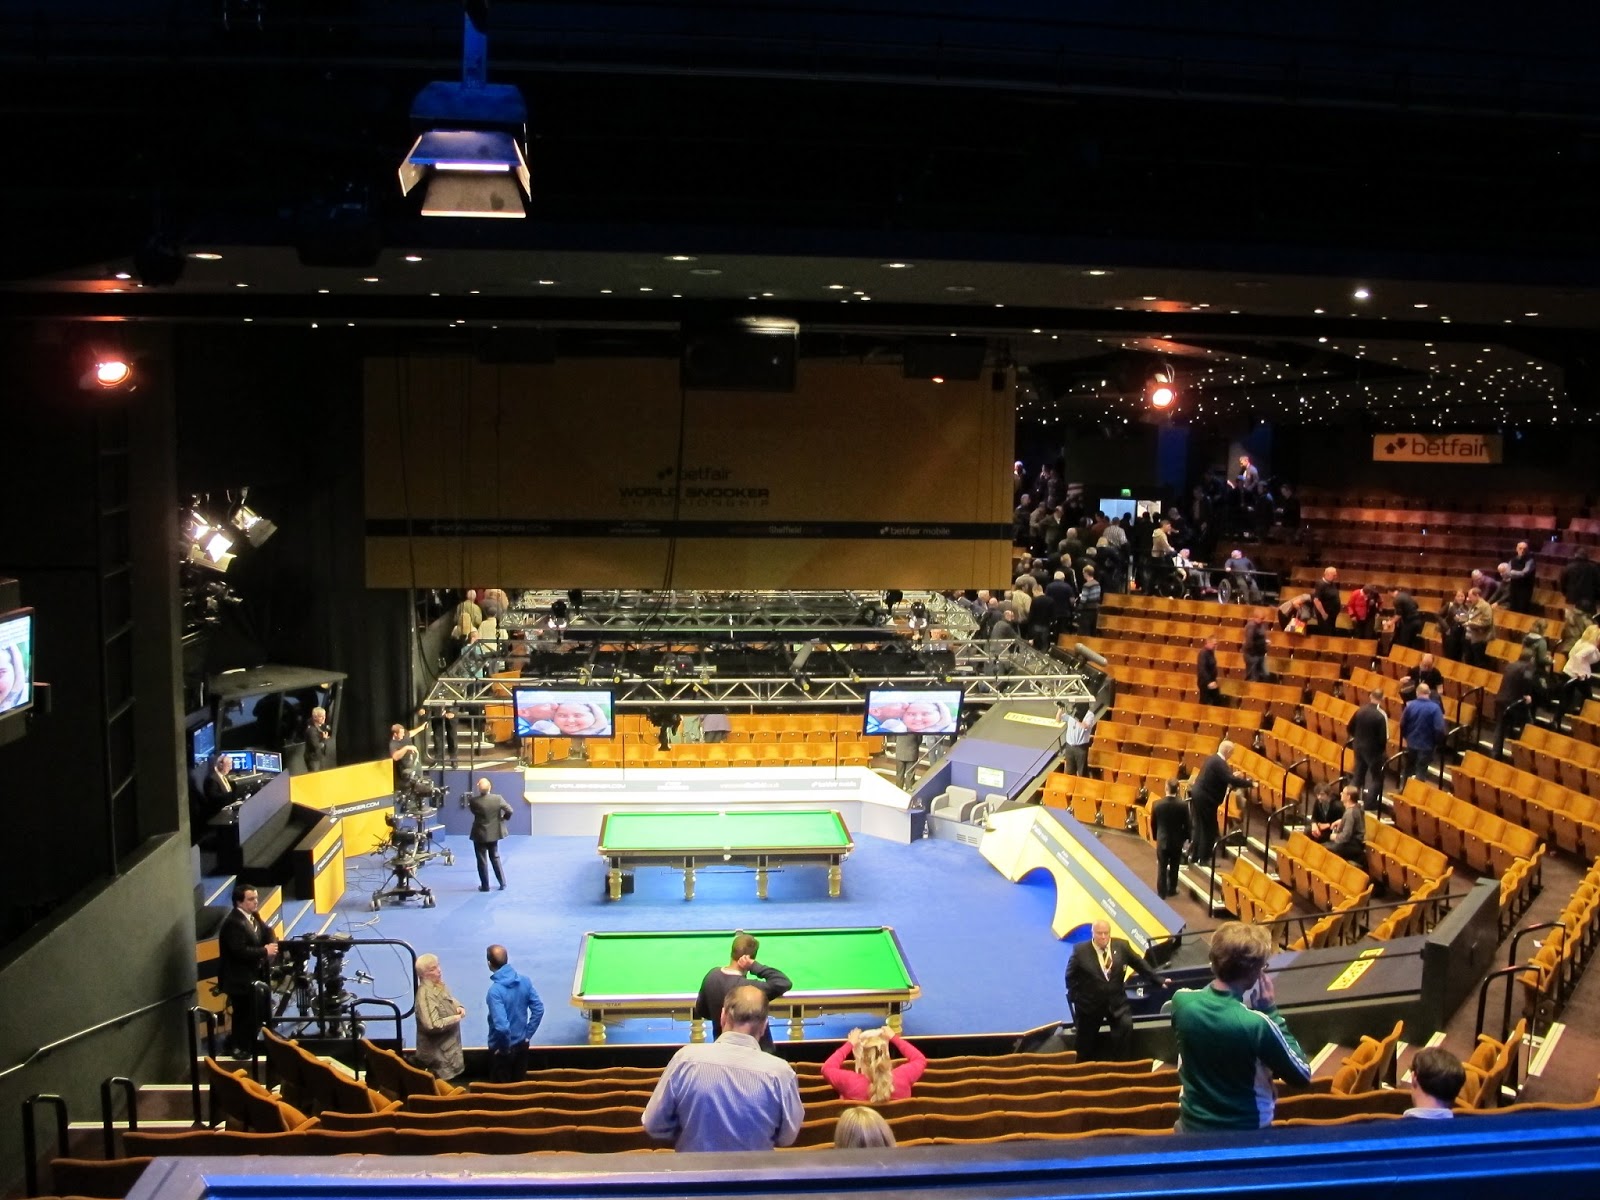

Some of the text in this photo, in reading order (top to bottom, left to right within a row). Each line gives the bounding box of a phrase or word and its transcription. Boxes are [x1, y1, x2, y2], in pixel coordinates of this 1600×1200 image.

[1411, 438, 1488, 457] betfair
[678, 467, 732, 480] betfair
[619, 488, 770, 498] WORLD SNOOKER
[890, 526, 951, 536] betfair mobile
